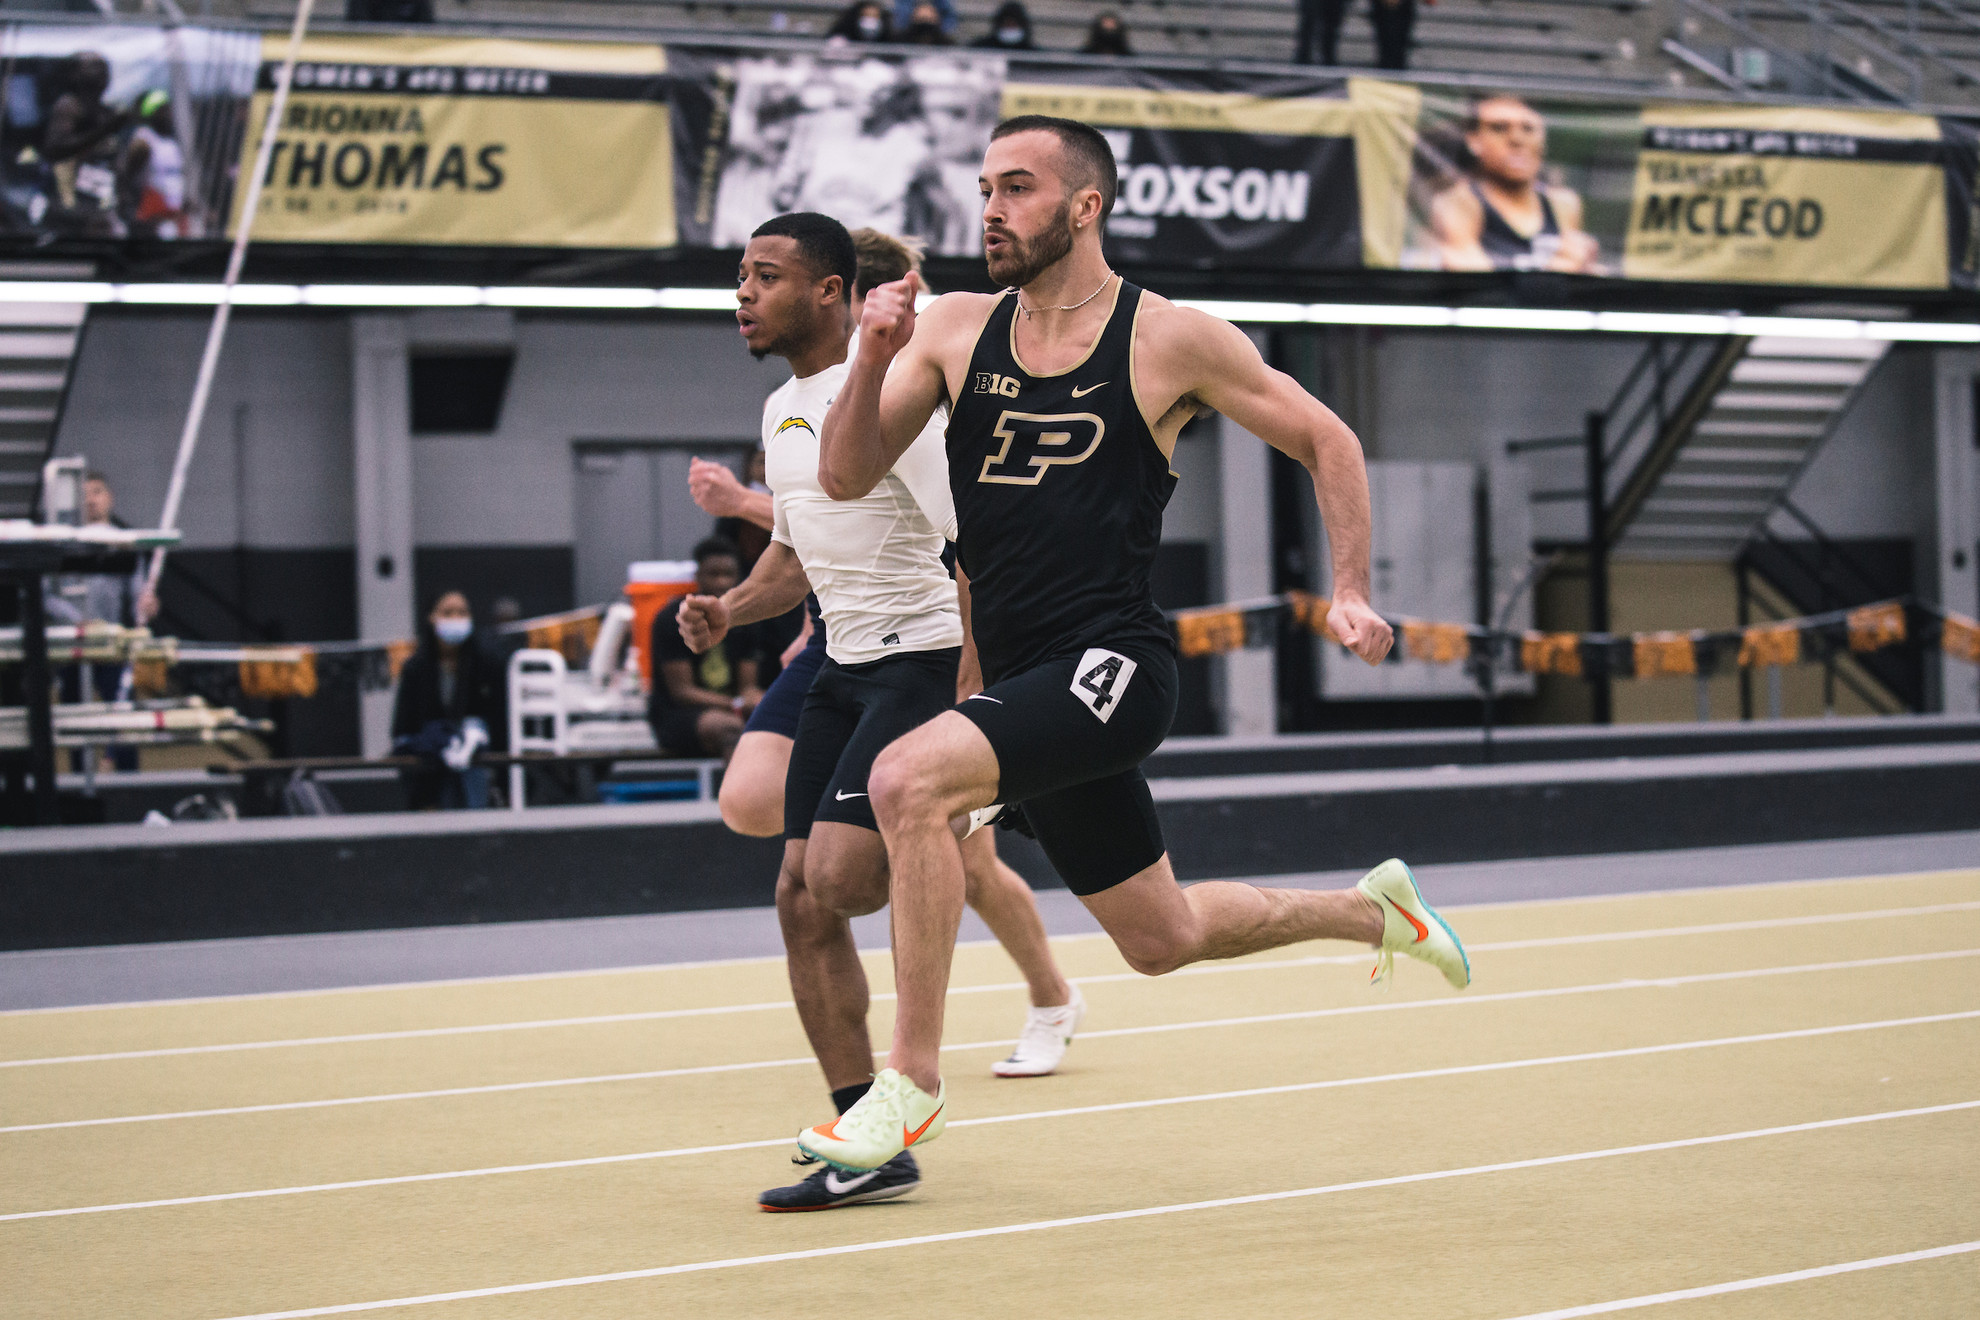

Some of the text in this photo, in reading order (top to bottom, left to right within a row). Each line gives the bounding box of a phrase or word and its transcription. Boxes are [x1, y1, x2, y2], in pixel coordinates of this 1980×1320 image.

[267, 103, 424, 134] RIONNA
[257, 142, 508, 192] THOMAS
[1640, 193, 1824, 239] MCLEOD
[977, 409, 1106, 486] P
[1079, 656, 1124, 712] 4
